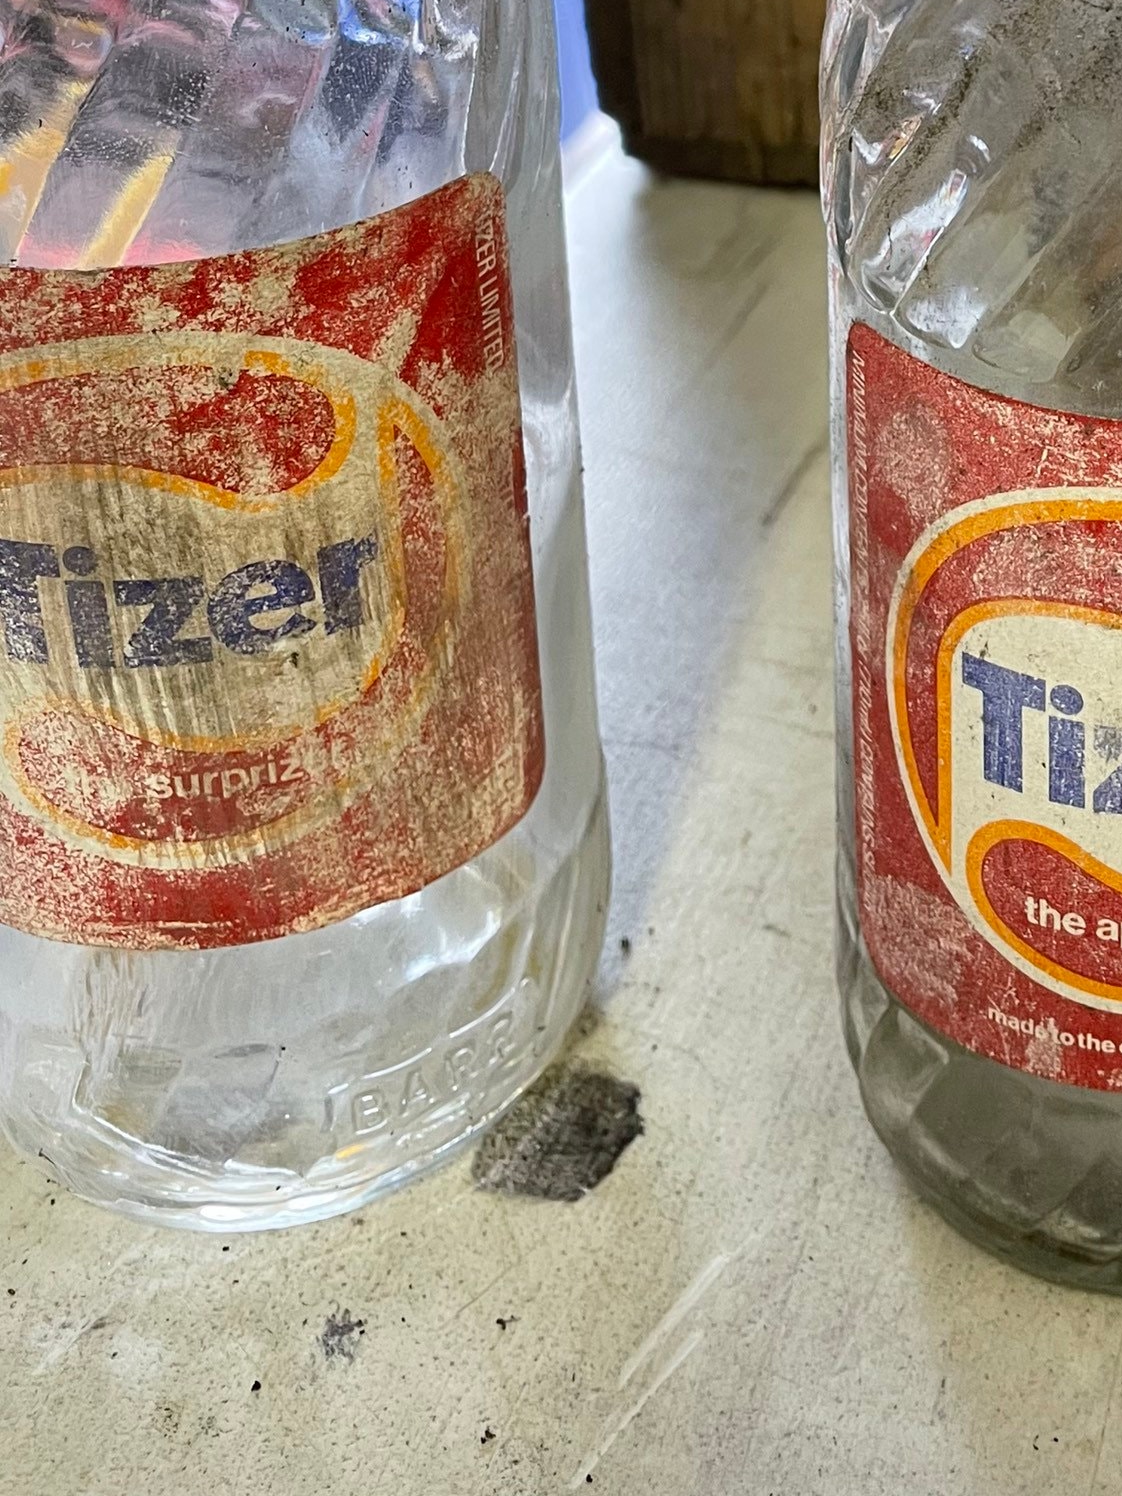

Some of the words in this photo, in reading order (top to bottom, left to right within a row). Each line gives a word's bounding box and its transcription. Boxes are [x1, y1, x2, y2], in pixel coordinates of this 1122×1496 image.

[476, 276, 505, 371] LIMITED
[0, 528, 379, 668] Tizer
[1024, 895, 1085, 936] the
[987, 1004, 1050, 1040] made
[1077, 1031, 1116, 1055] the
